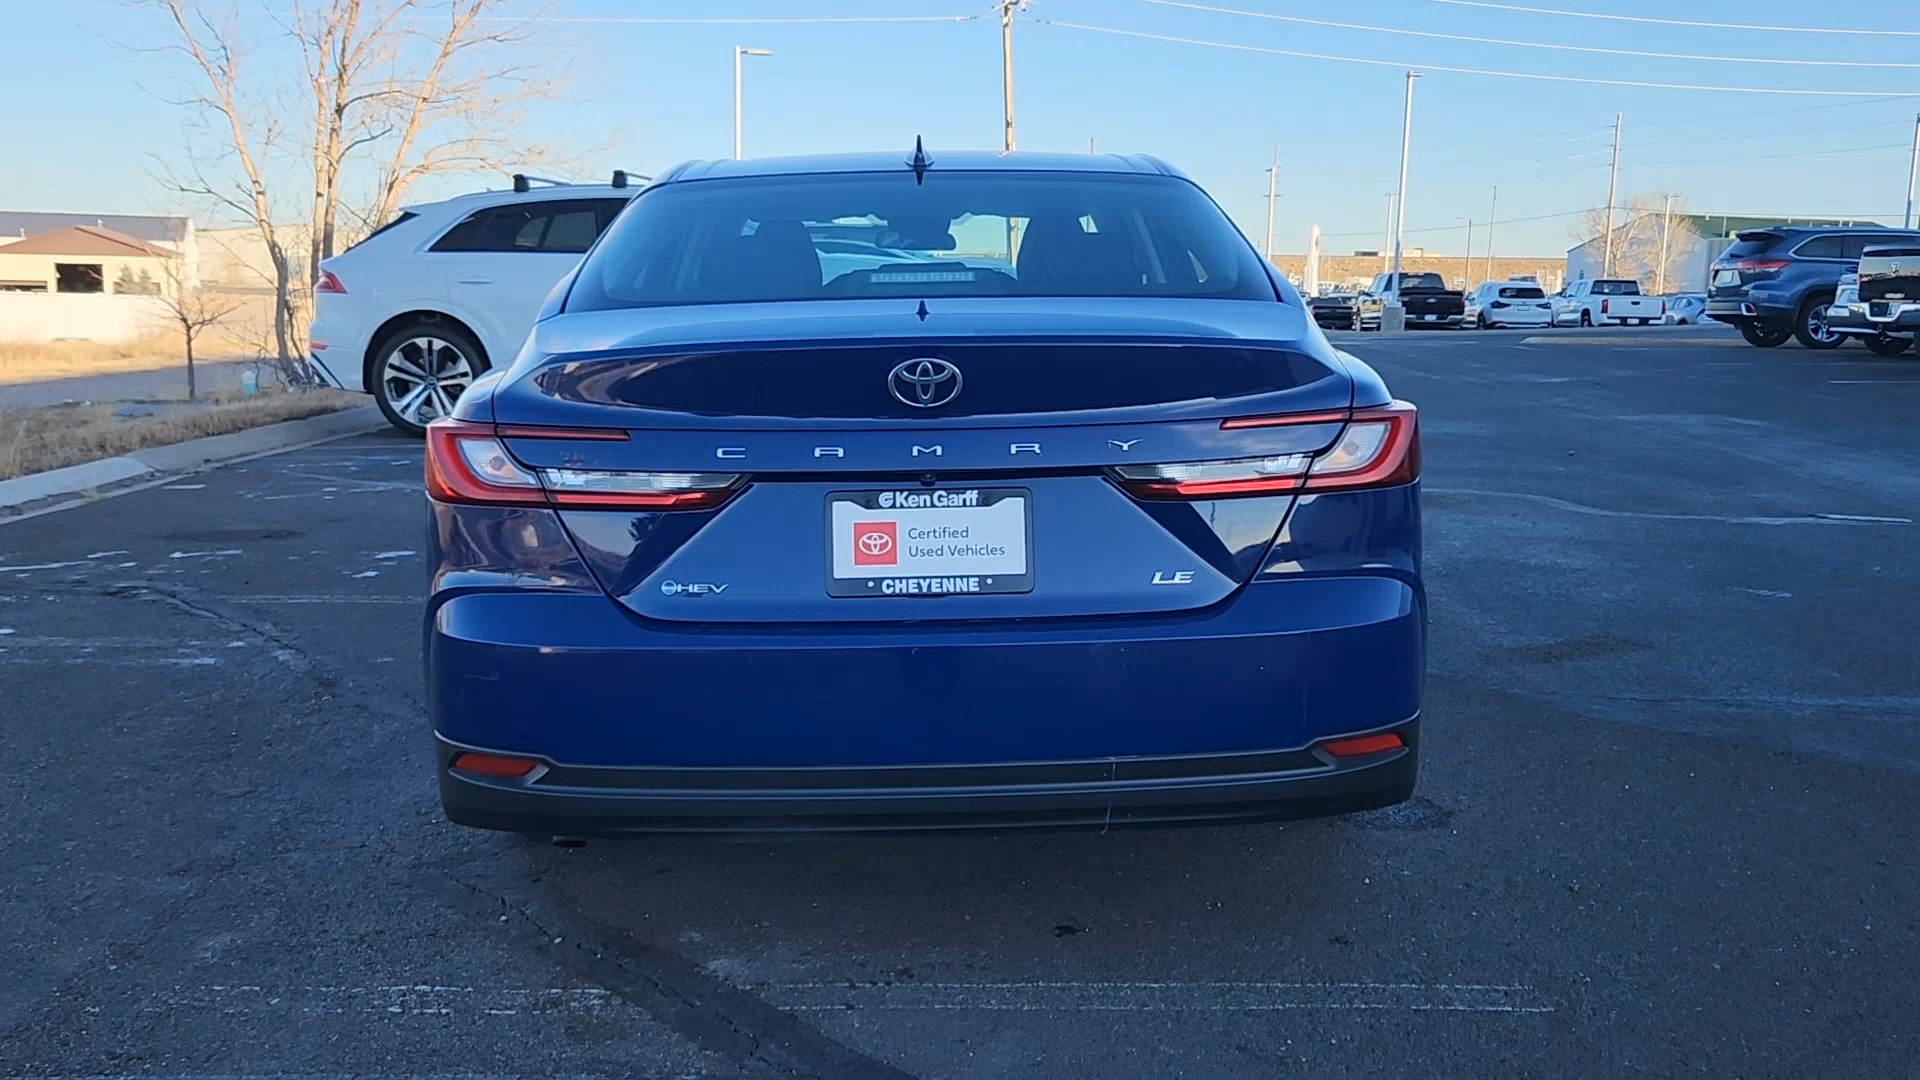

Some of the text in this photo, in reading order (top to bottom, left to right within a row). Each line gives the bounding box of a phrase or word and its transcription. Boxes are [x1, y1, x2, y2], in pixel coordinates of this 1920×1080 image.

[716, 438, 1144, 459] CAMRY
[895, 490, 979, 508] Ken Garff
[907, 526, 969, 540] Certified
[908, 544, 1006, 558] Used Vehicles
[1151, 571, 1196, 584] LE
[881, 577, 980, 595] CHEYENNE
